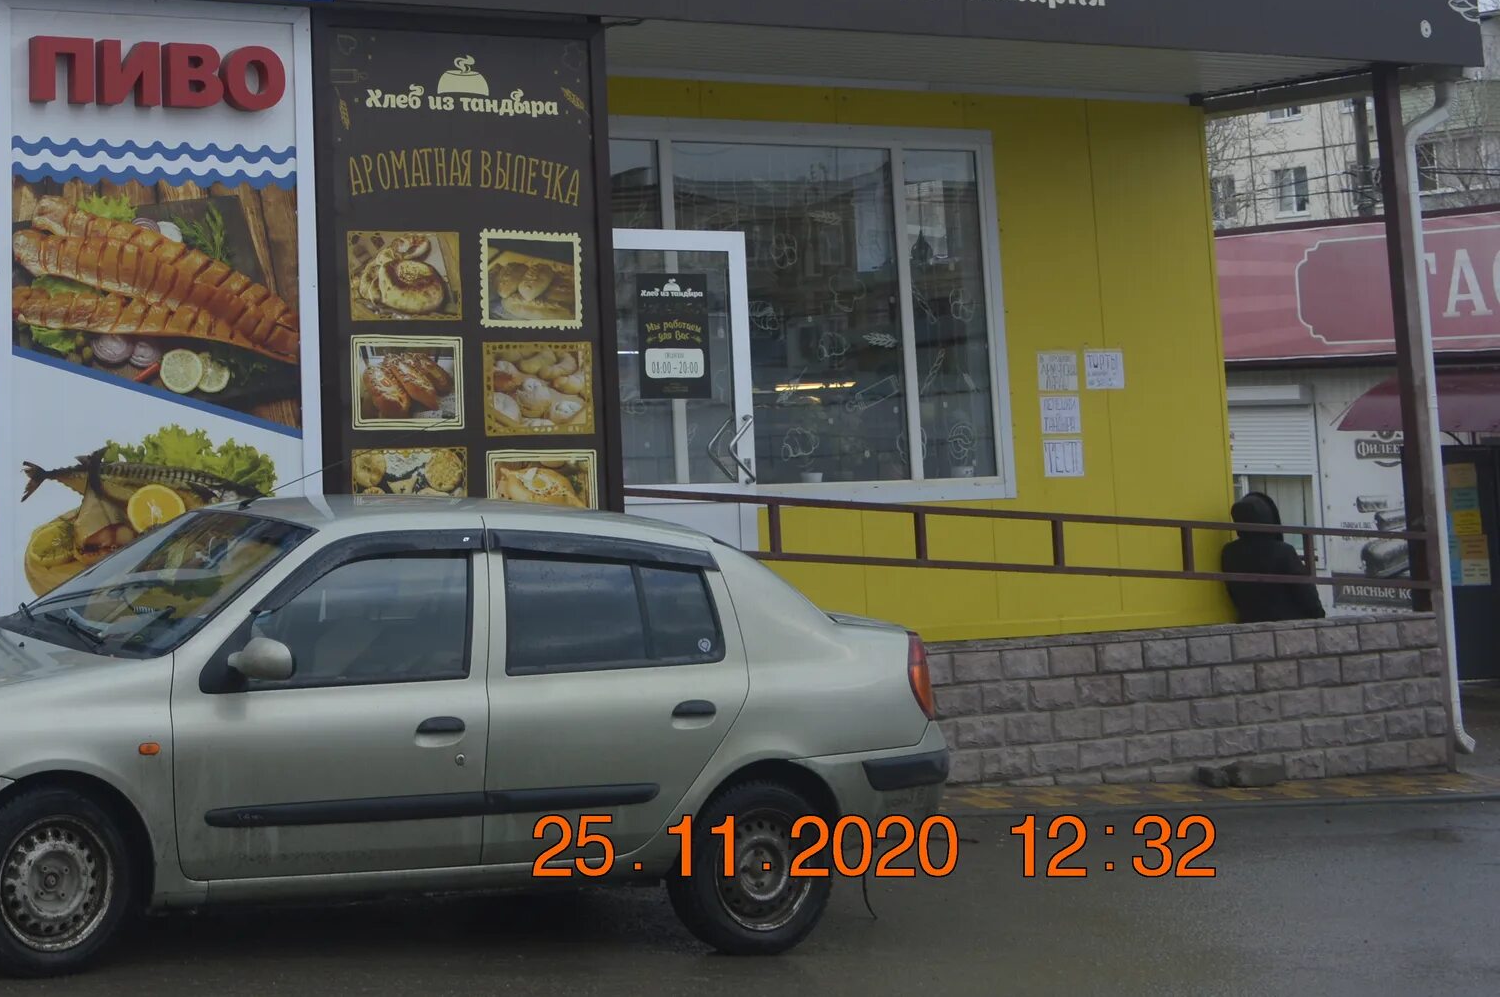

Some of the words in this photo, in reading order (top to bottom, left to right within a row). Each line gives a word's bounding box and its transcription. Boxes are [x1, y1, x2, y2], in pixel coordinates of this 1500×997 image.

[28, 35, 286, 113] ПИВО
[365, 84, 425, 109] Хлеб
[428, 94, 455, 111] из
[460, 88, 559, 118] тандыра
[349, 147, 472, 197] АРОМАТНАЯ
[479, 150, 581, 207] ВЫПЕЧКА
[640, 287, 660, 297] Хлеб
